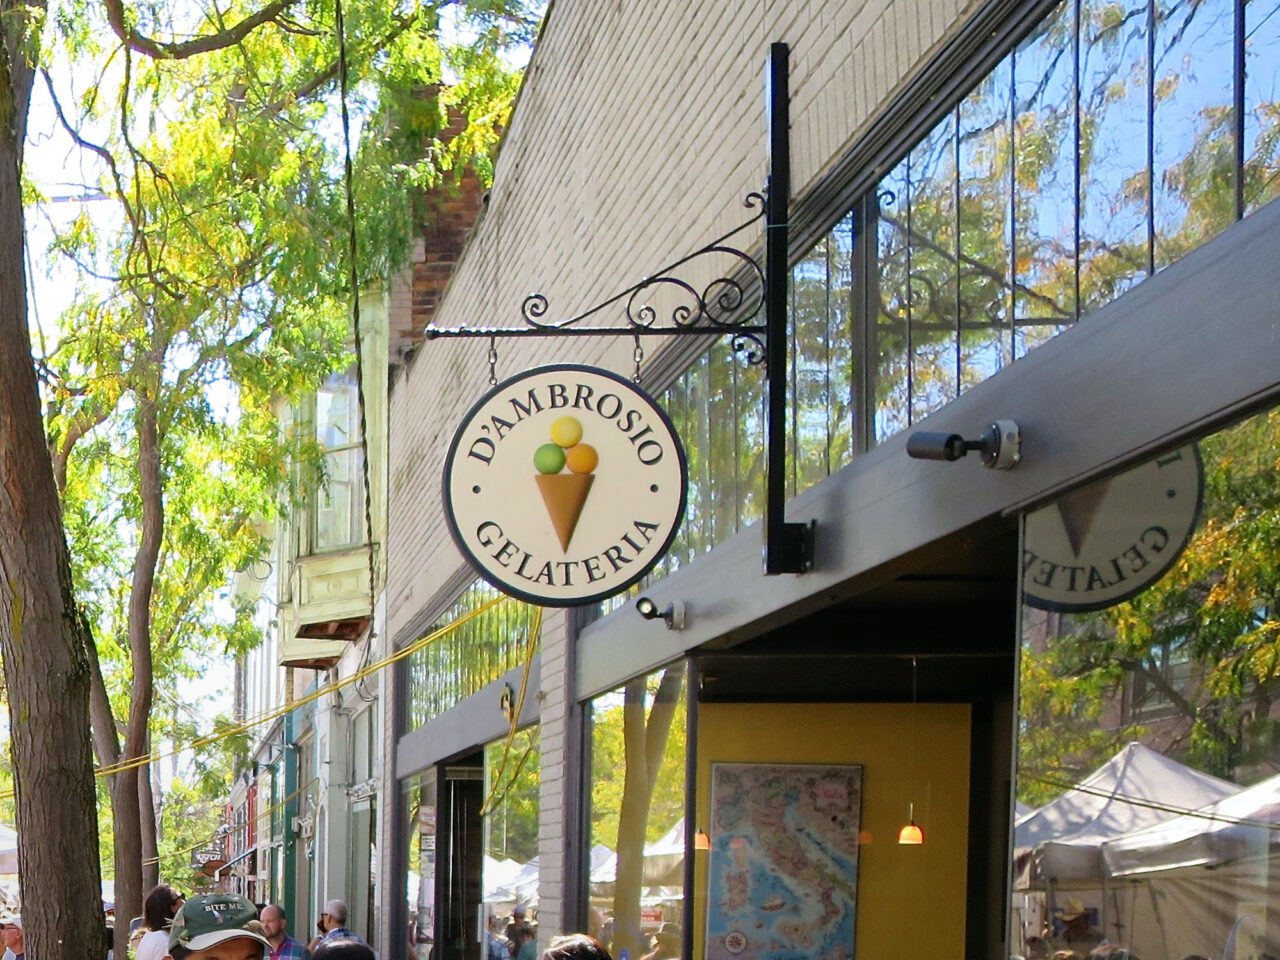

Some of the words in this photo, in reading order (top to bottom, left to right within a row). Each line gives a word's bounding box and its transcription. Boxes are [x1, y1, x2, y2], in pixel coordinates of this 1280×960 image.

[467, 383, 665, 467] D'AMBROSIO
[476, 519, 661, 587] GELATERIA
[205, 903, 227, 912] BITE
[228, 902, 244, 910] ME
